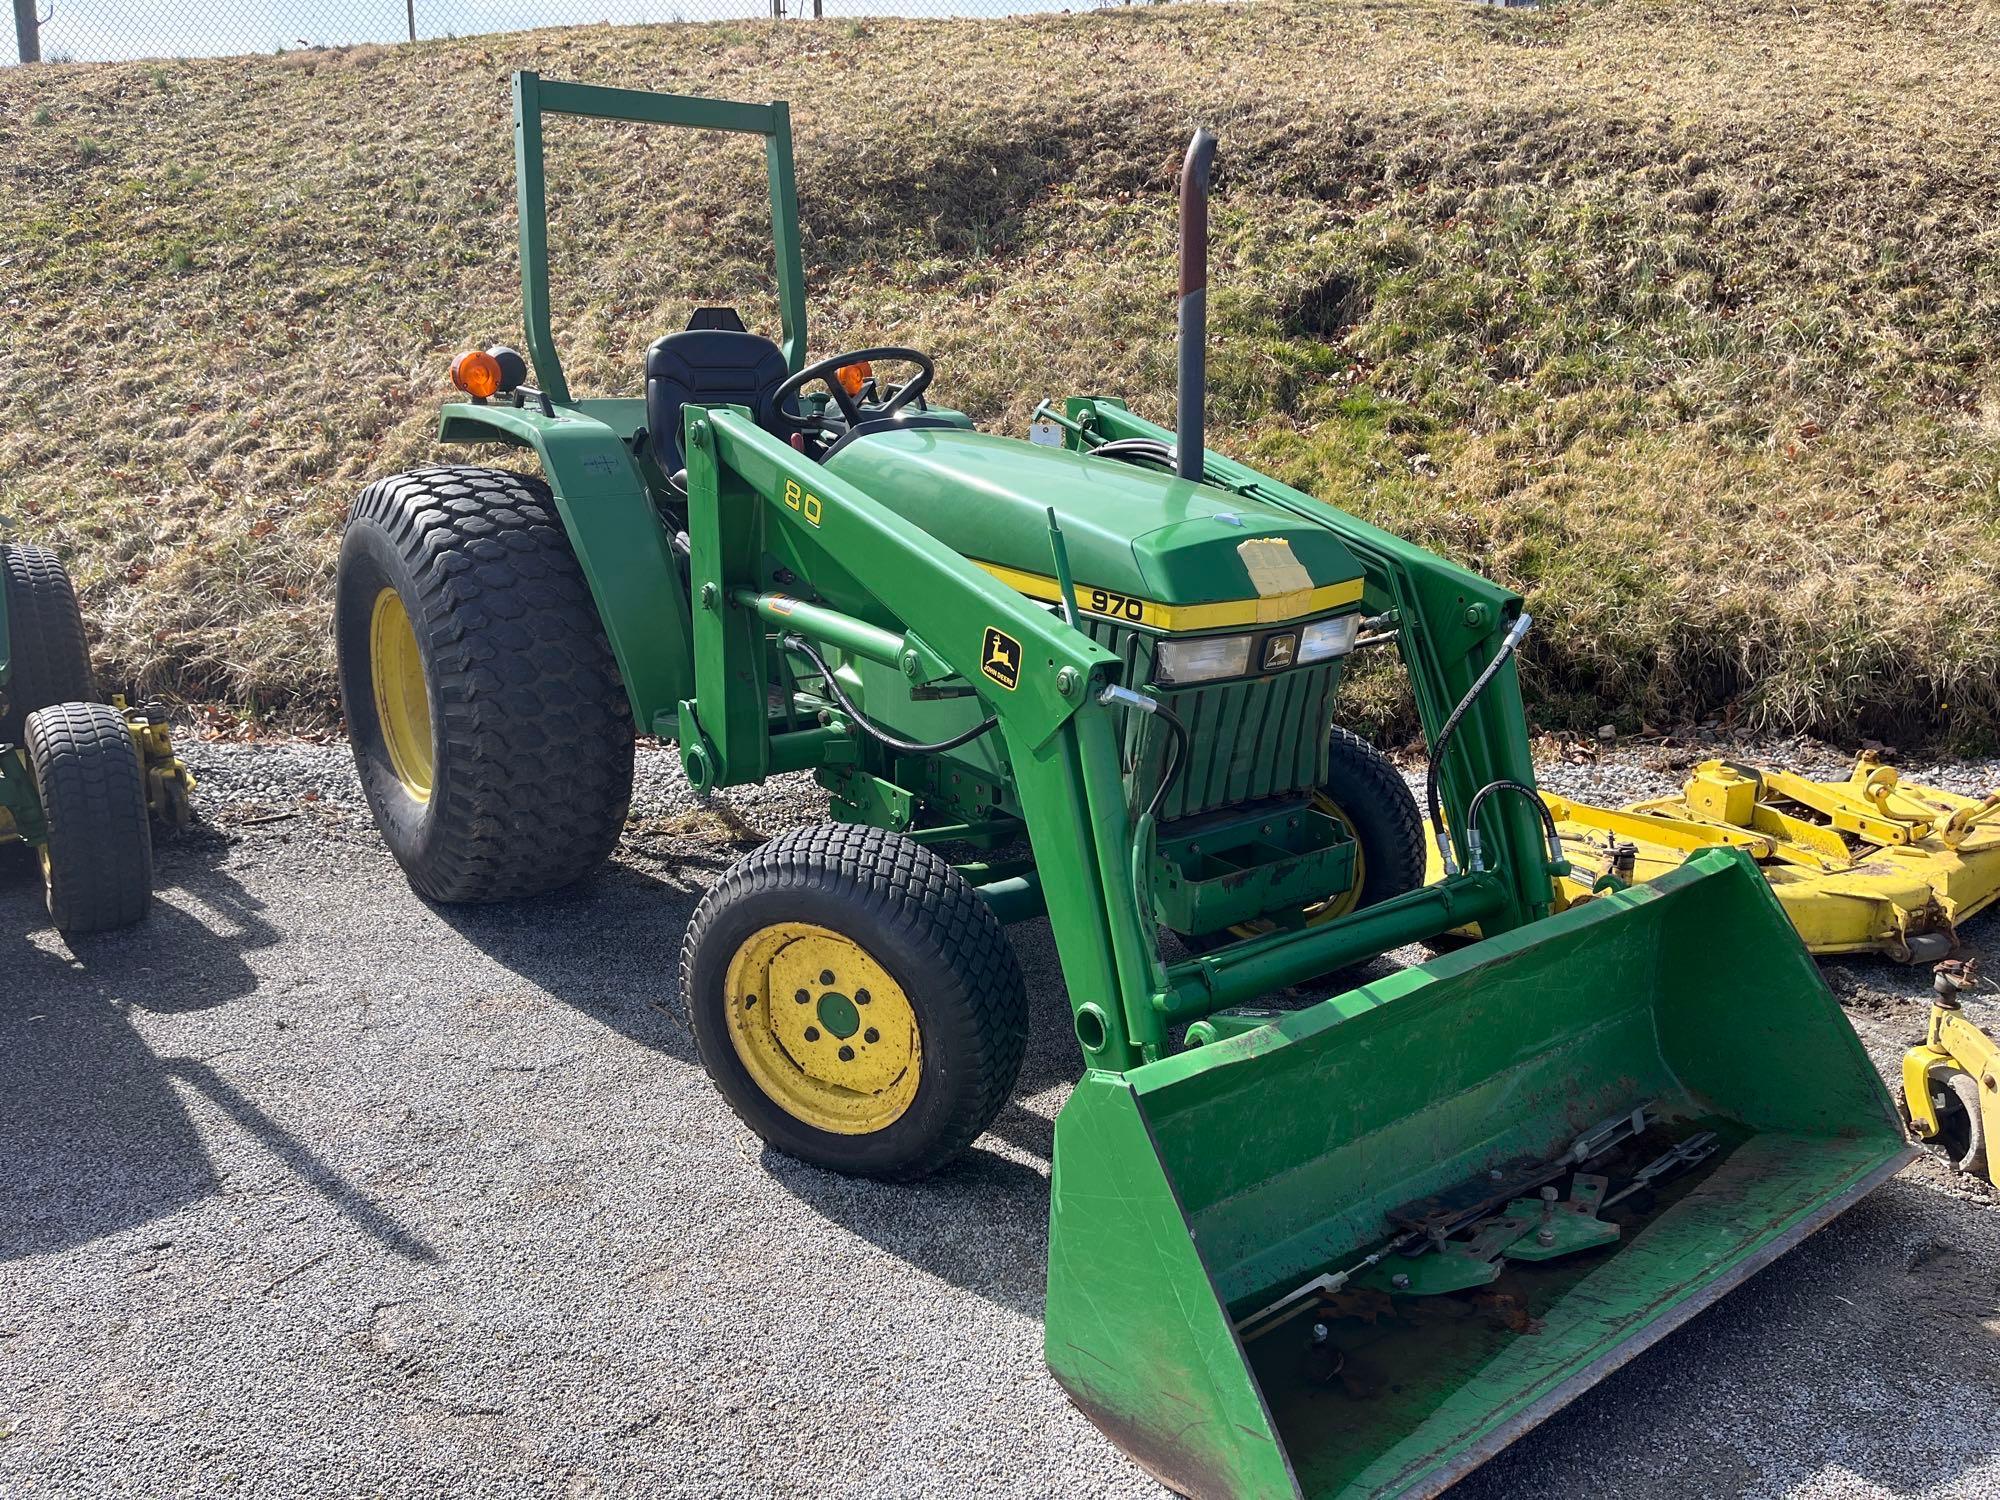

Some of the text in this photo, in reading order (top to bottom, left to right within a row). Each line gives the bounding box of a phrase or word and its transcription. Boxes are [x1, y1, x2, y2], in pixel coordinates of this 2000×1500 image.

[784, 479, 822, 526] 80
[1091, 590, 1143, 621] 970
[984, 664, 1014, 686] JOHN DEERE
